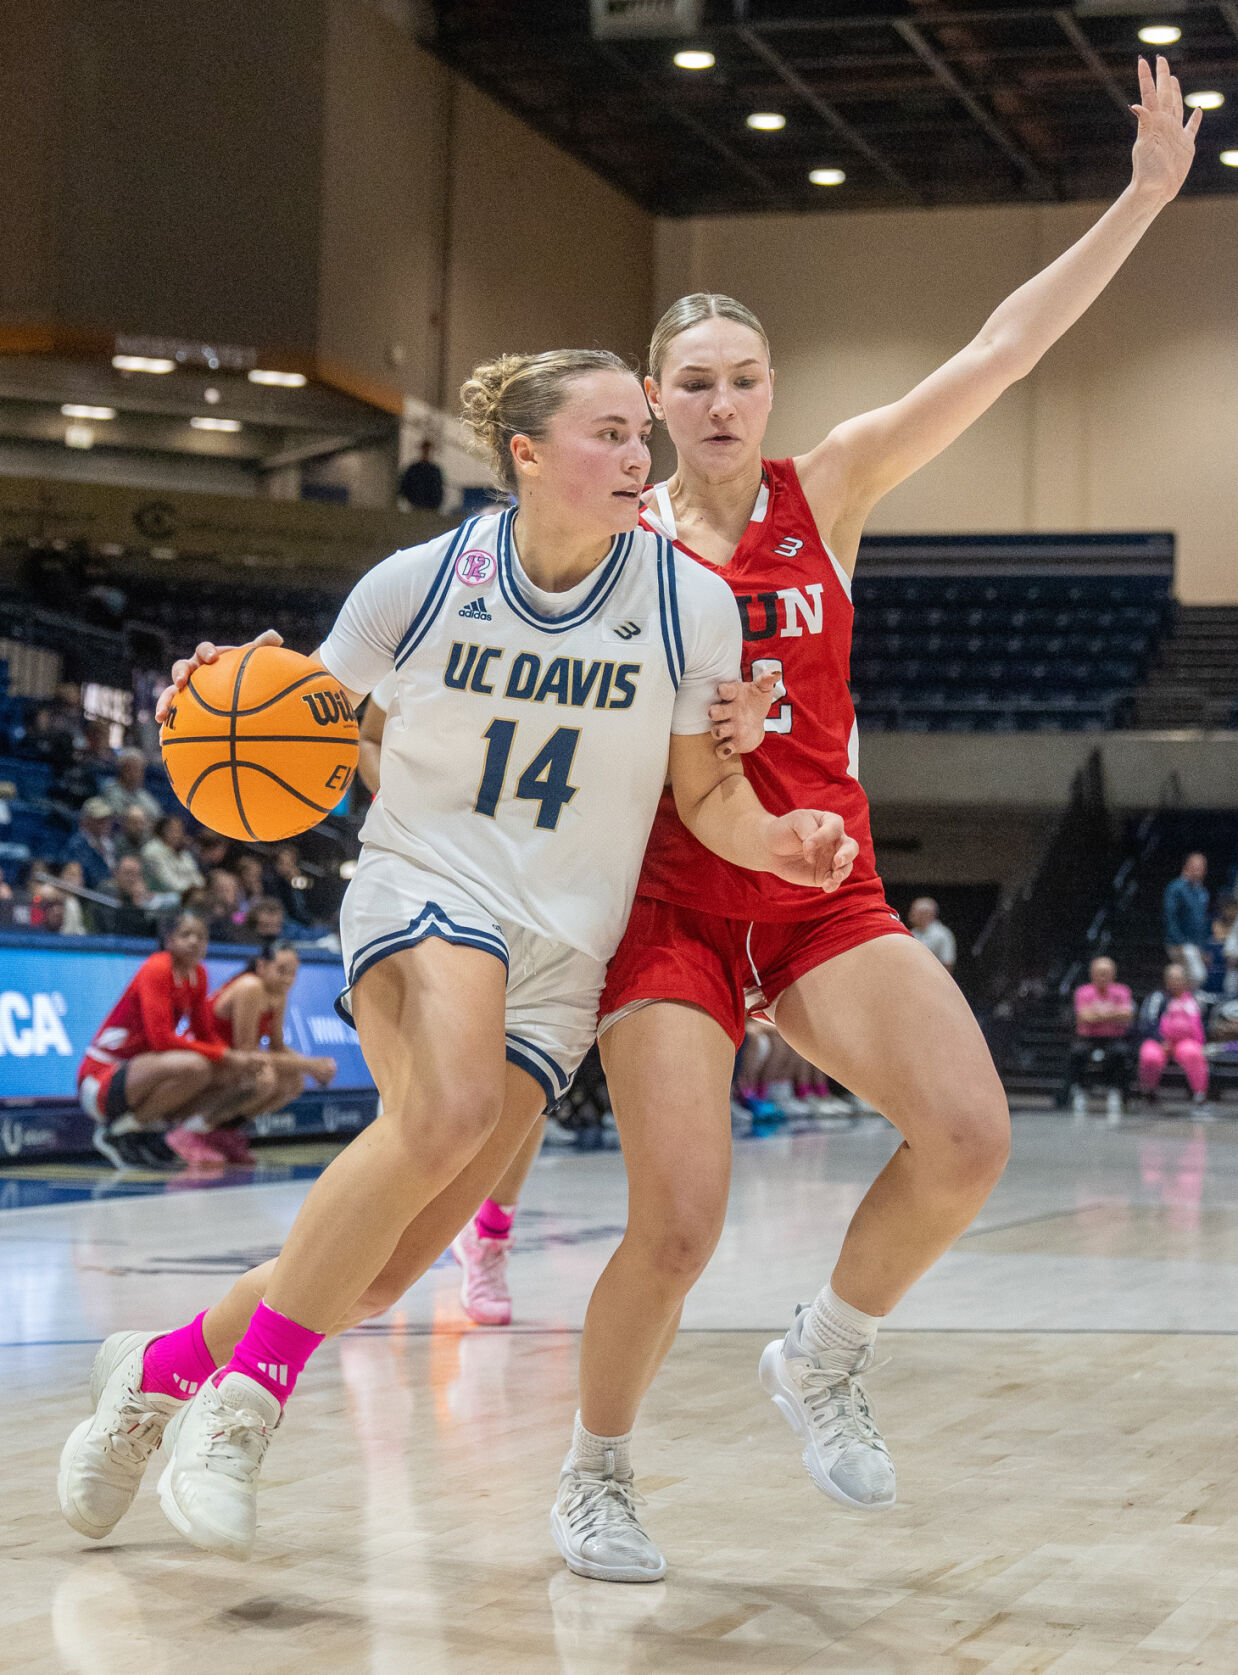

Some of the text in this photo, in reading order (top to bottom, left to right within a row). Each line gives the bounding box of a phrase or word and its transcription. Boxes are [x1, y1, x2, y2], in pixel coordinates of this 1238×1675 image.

[458, 608, 492, 621] adidas
[442, 640, 643, 711] UC DAVIS
[472, 716, 583, 833] 14
